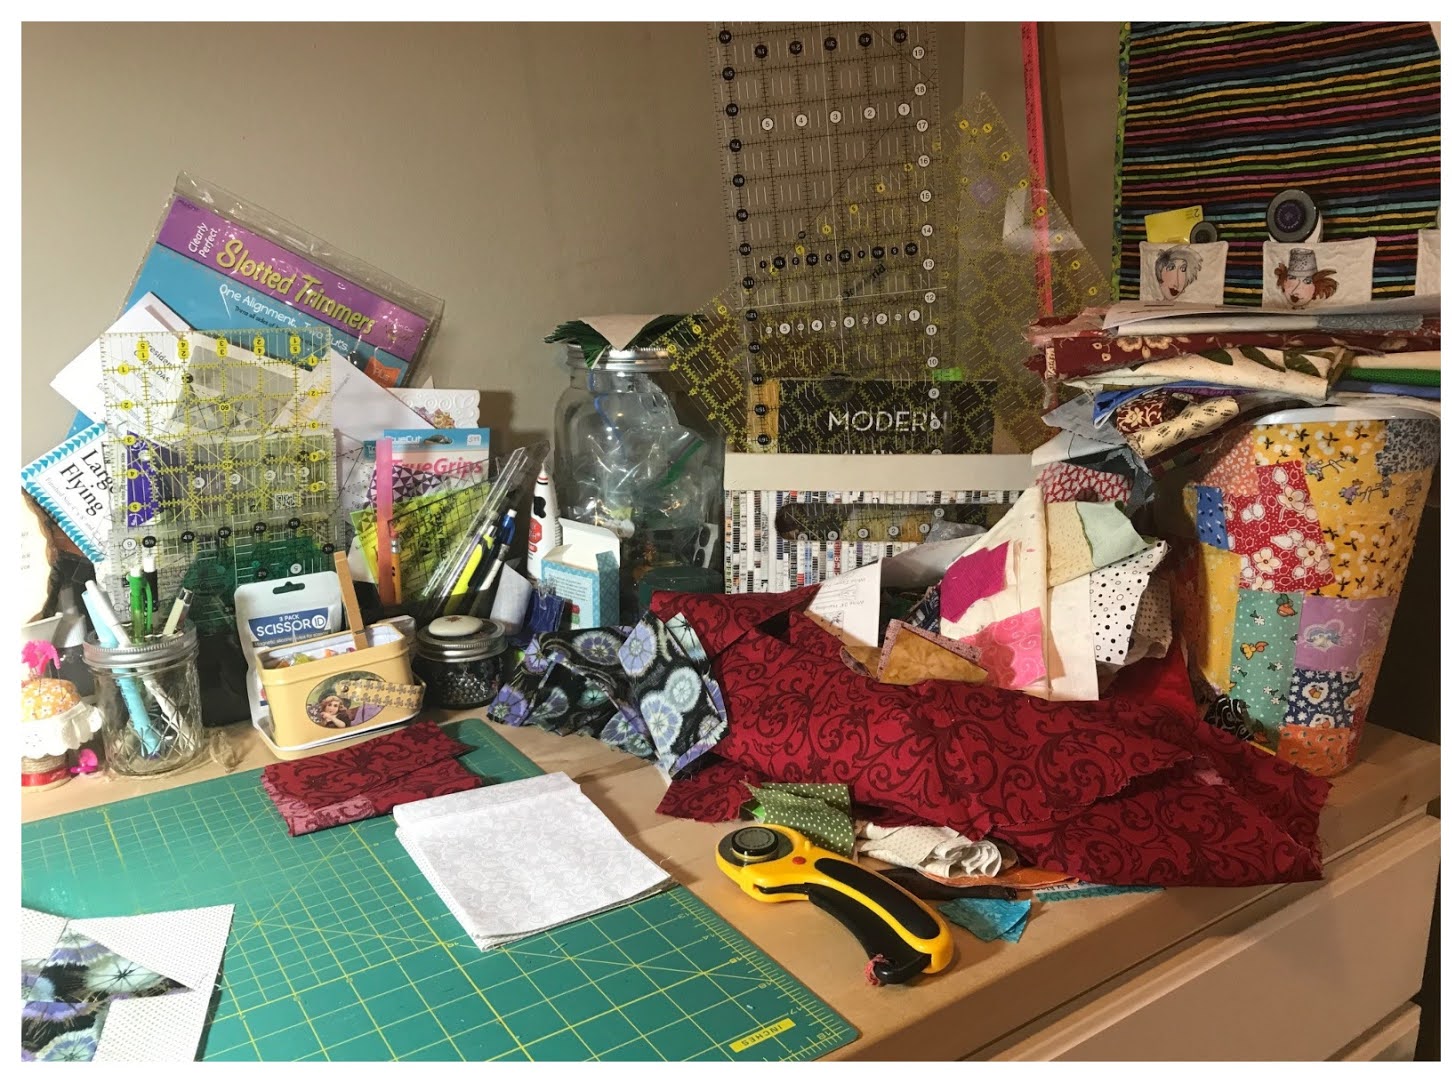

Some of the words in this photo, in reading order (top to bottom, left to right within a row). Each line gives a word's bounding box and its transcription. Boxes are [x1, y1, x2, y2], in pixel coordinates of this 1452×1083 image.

[188, 222, 208, 253] Clearly
[216, 239, 297, 295] Slotted
[294, 273, 377, 335] Trimmers
[828, 410, 948, 432] MODERN
[59, 462, 104, 517] Flying
[256, 618, 311, 637] SCISSOR
[740, 1023, 784, 1047] INCHES
